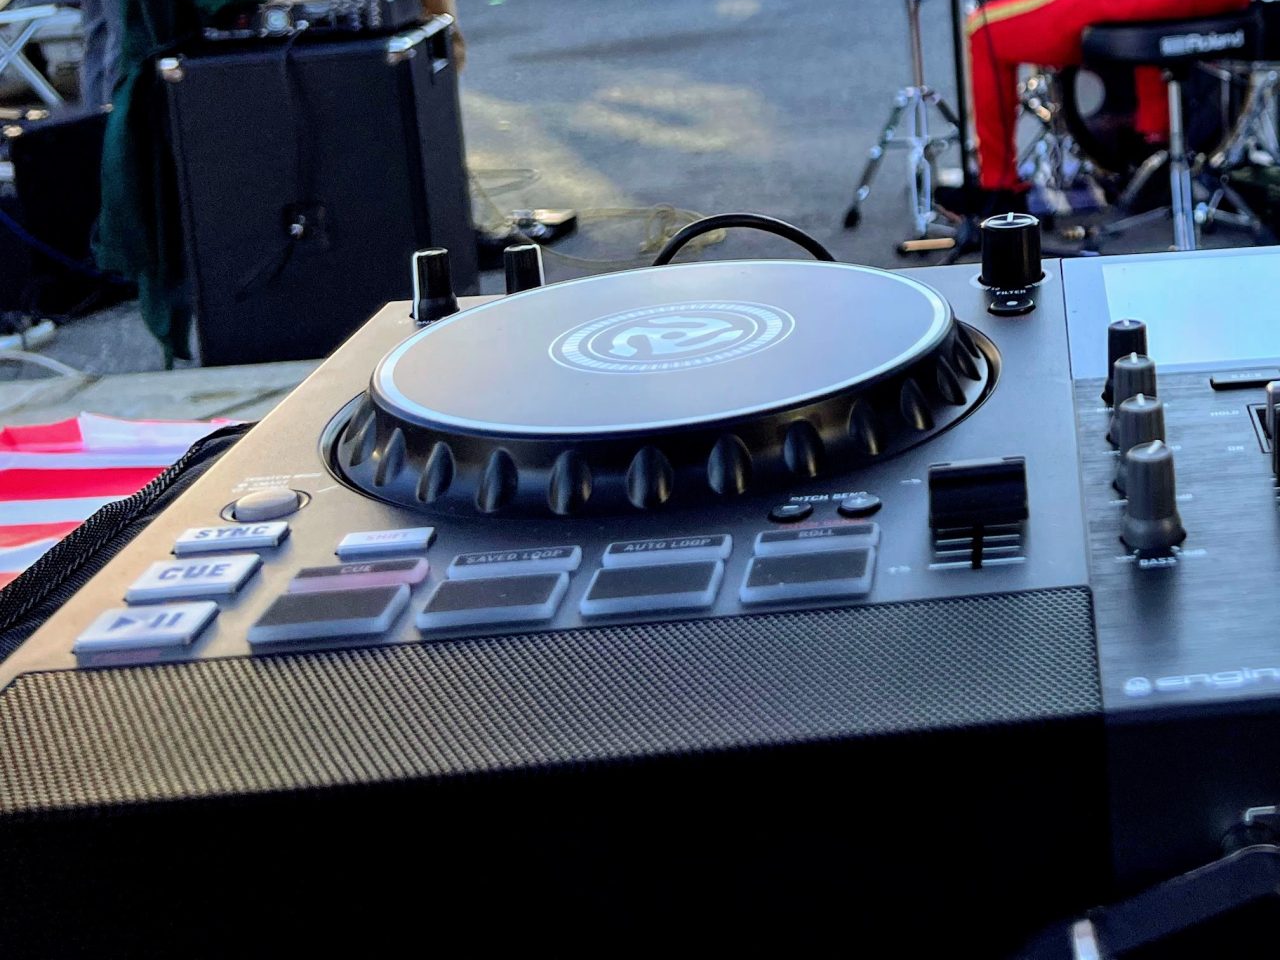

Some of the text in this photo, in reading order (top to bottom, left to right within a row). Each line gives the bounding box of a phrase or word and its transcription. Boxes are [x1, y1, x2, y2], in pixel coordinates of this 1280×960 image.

[790, 493, 829, 502] PITCH
[194, 524, 270, 540] SYNC
[623, 537, 712, 553] AUTO LOOP
[465, 548, 565, 565] SAVED LOOP
[1138, 557, 1178, 569] BASS
[157, 562, 233, 582] CUE
[340, 564, 373, 575] CUE
